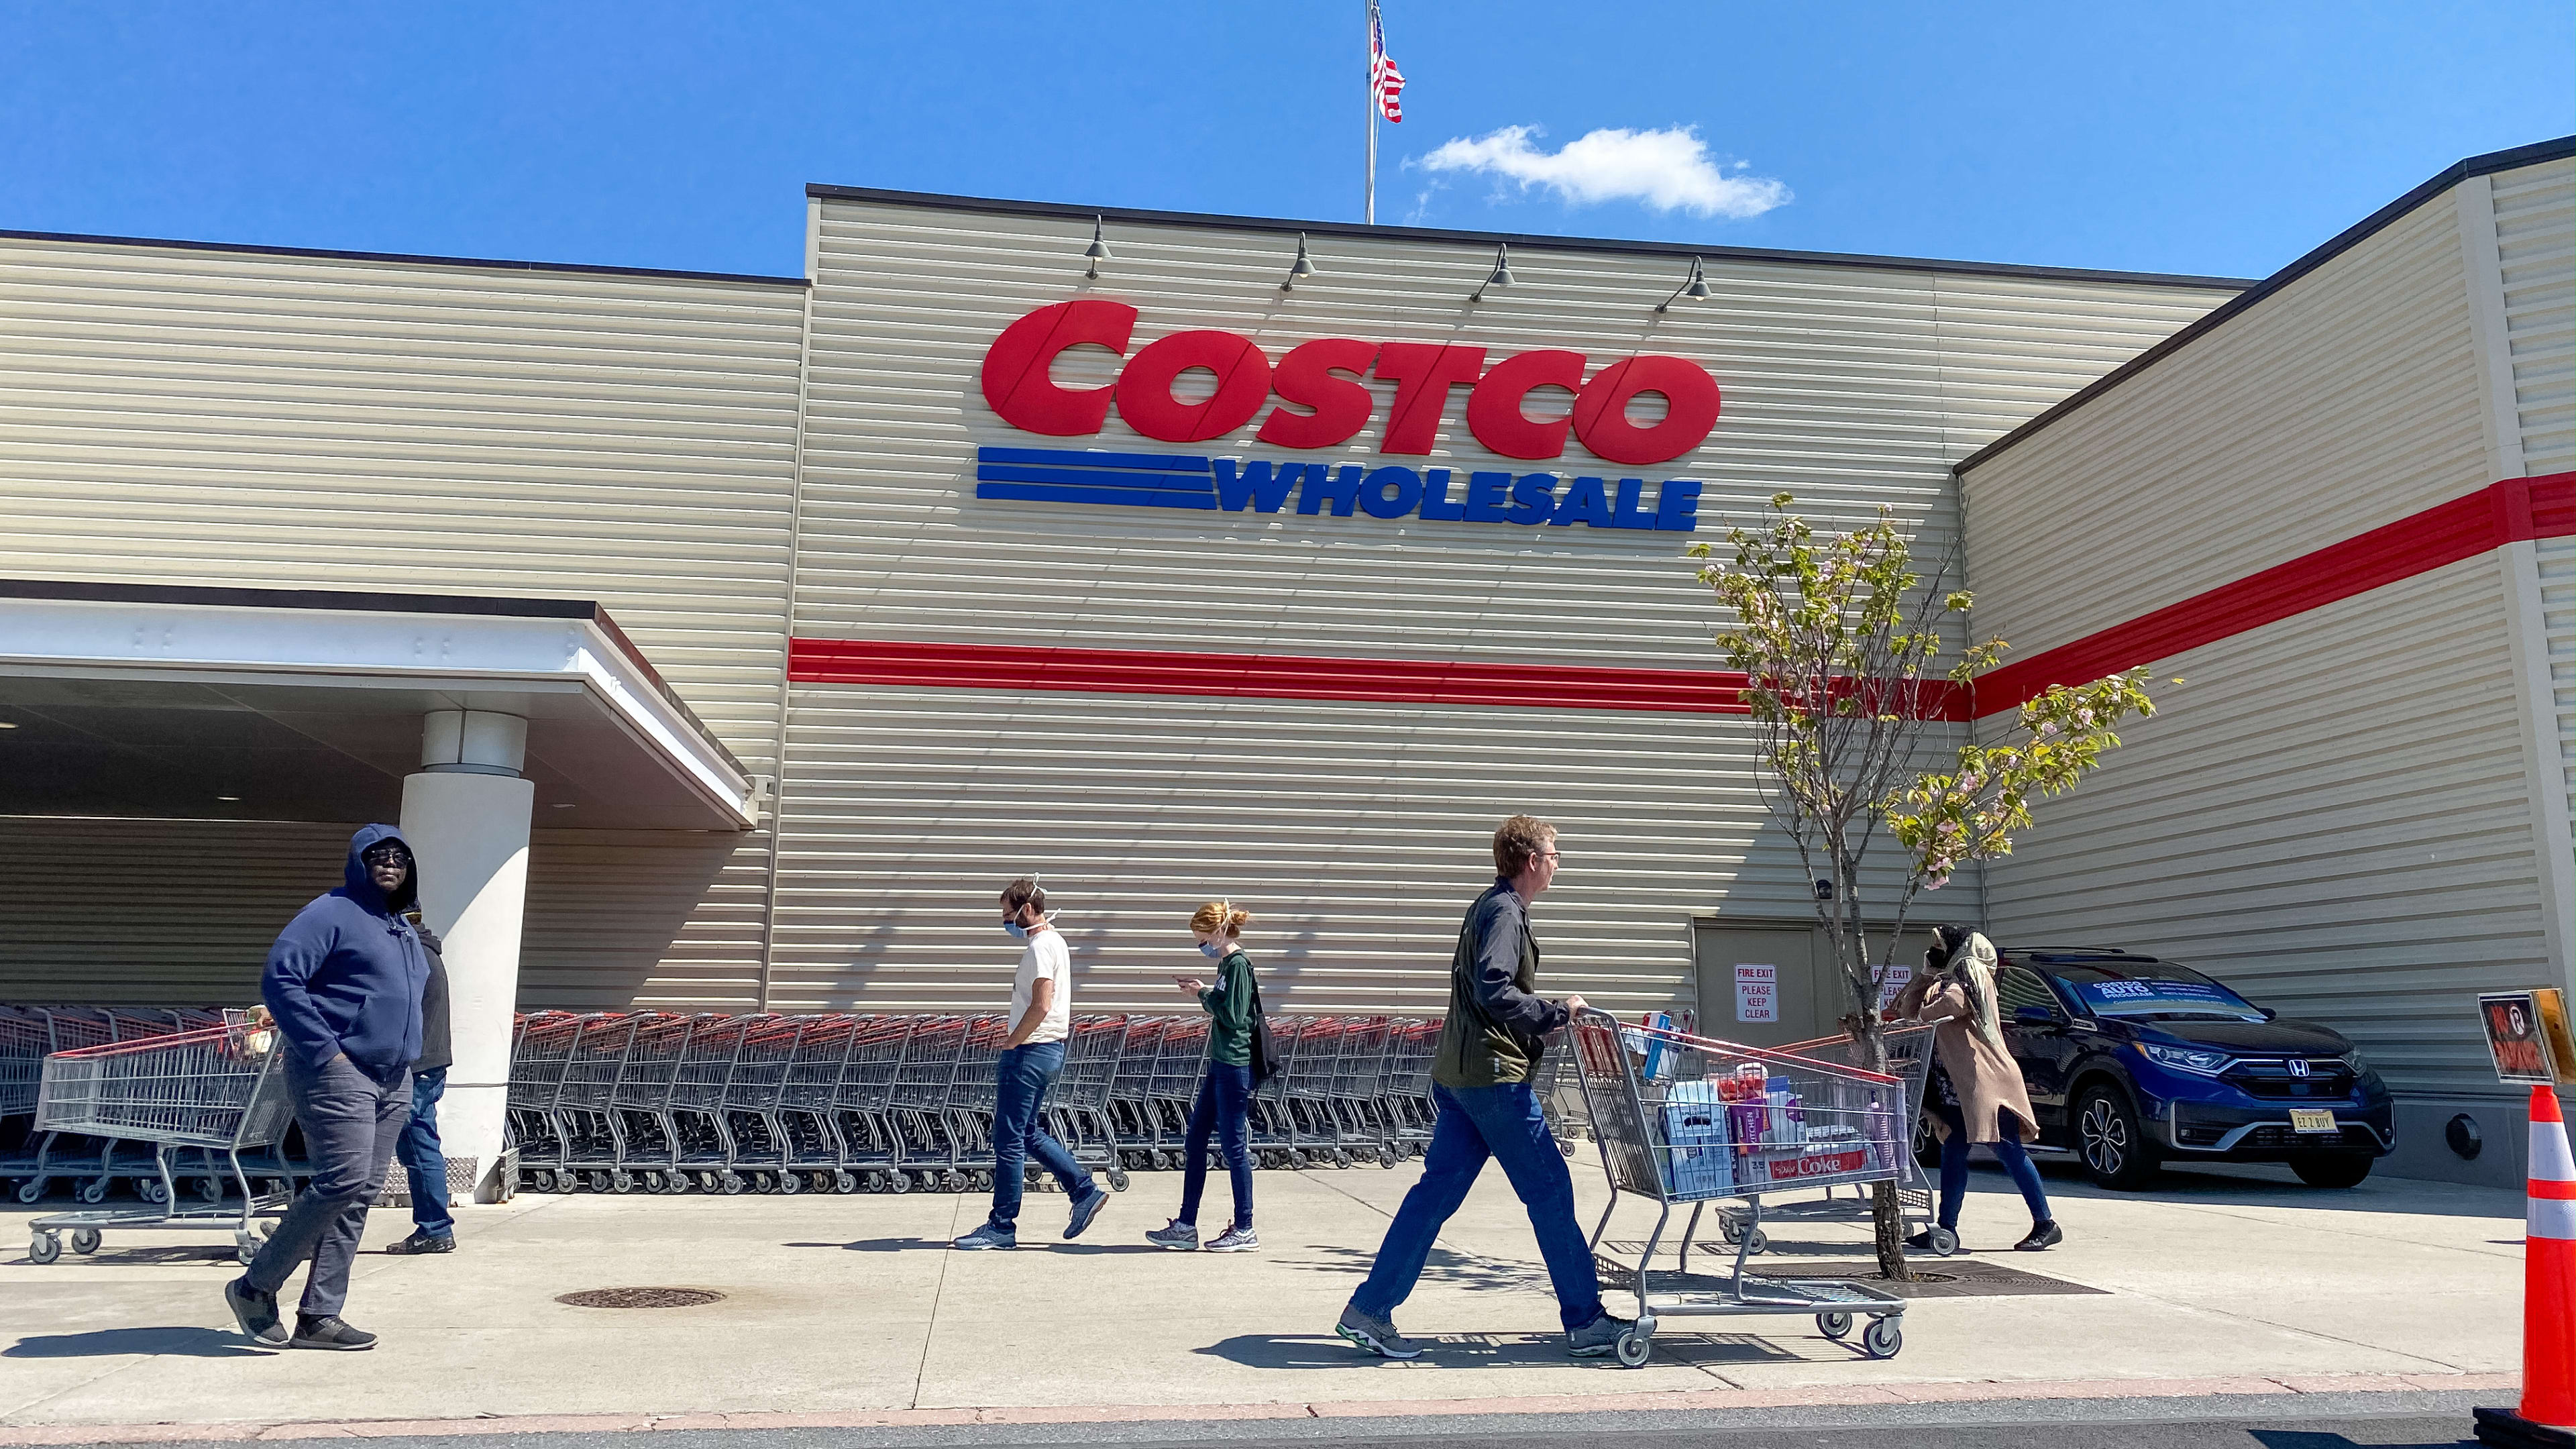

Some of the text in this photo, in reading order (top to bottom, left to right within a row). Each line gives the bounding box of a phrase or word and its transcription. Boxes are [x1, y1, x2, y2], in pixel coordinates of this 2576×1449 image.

[981, 299, 1721, 464] COSTCO
[1212, 459, 1703, 531] WHOLESALE
[1737, 968, 1774, 978] FIRE EXIT
[1892, 970, 1909, 979] EXIT
[2092, 981, 2143, 989] COSTCO
[2101, 985, 2149, 995] AUTO
[1741, 985, 1772, 996] PLEASE
[1747, 998, 1767, 1007] KEEP
[1745, 1009, 1770, 1019] CLEAR
[2297, 1116, 2330, 1128] EZ 2 BUY
[1798, 1158, 1841, 1175] Coke
